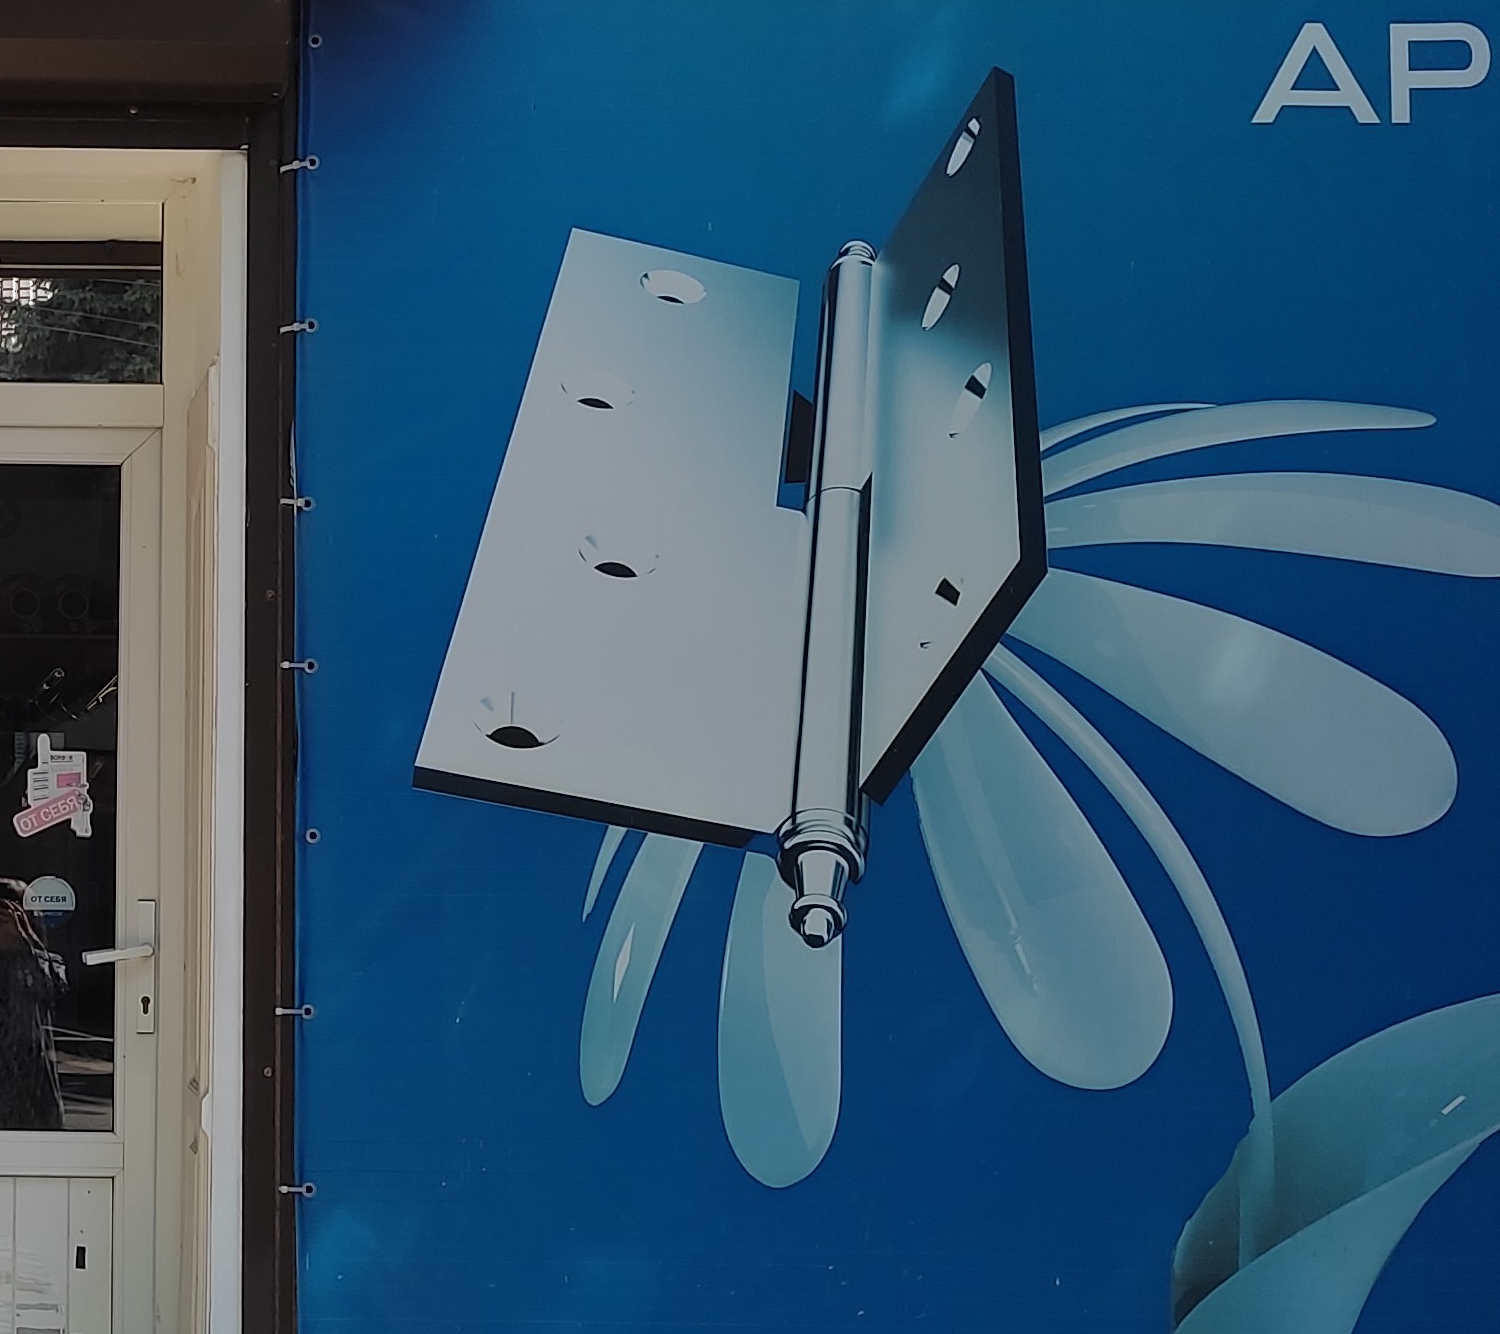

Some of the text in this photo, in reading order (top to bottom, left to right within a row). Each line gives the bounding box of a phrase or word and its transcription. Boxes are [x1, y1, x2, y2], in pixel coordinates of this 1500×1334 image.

[1250, 22, 1491, 123] AP
[19, 795, 77, 831] ОТ СЕБЯ
[30, 895, 42, 903] ОТ
